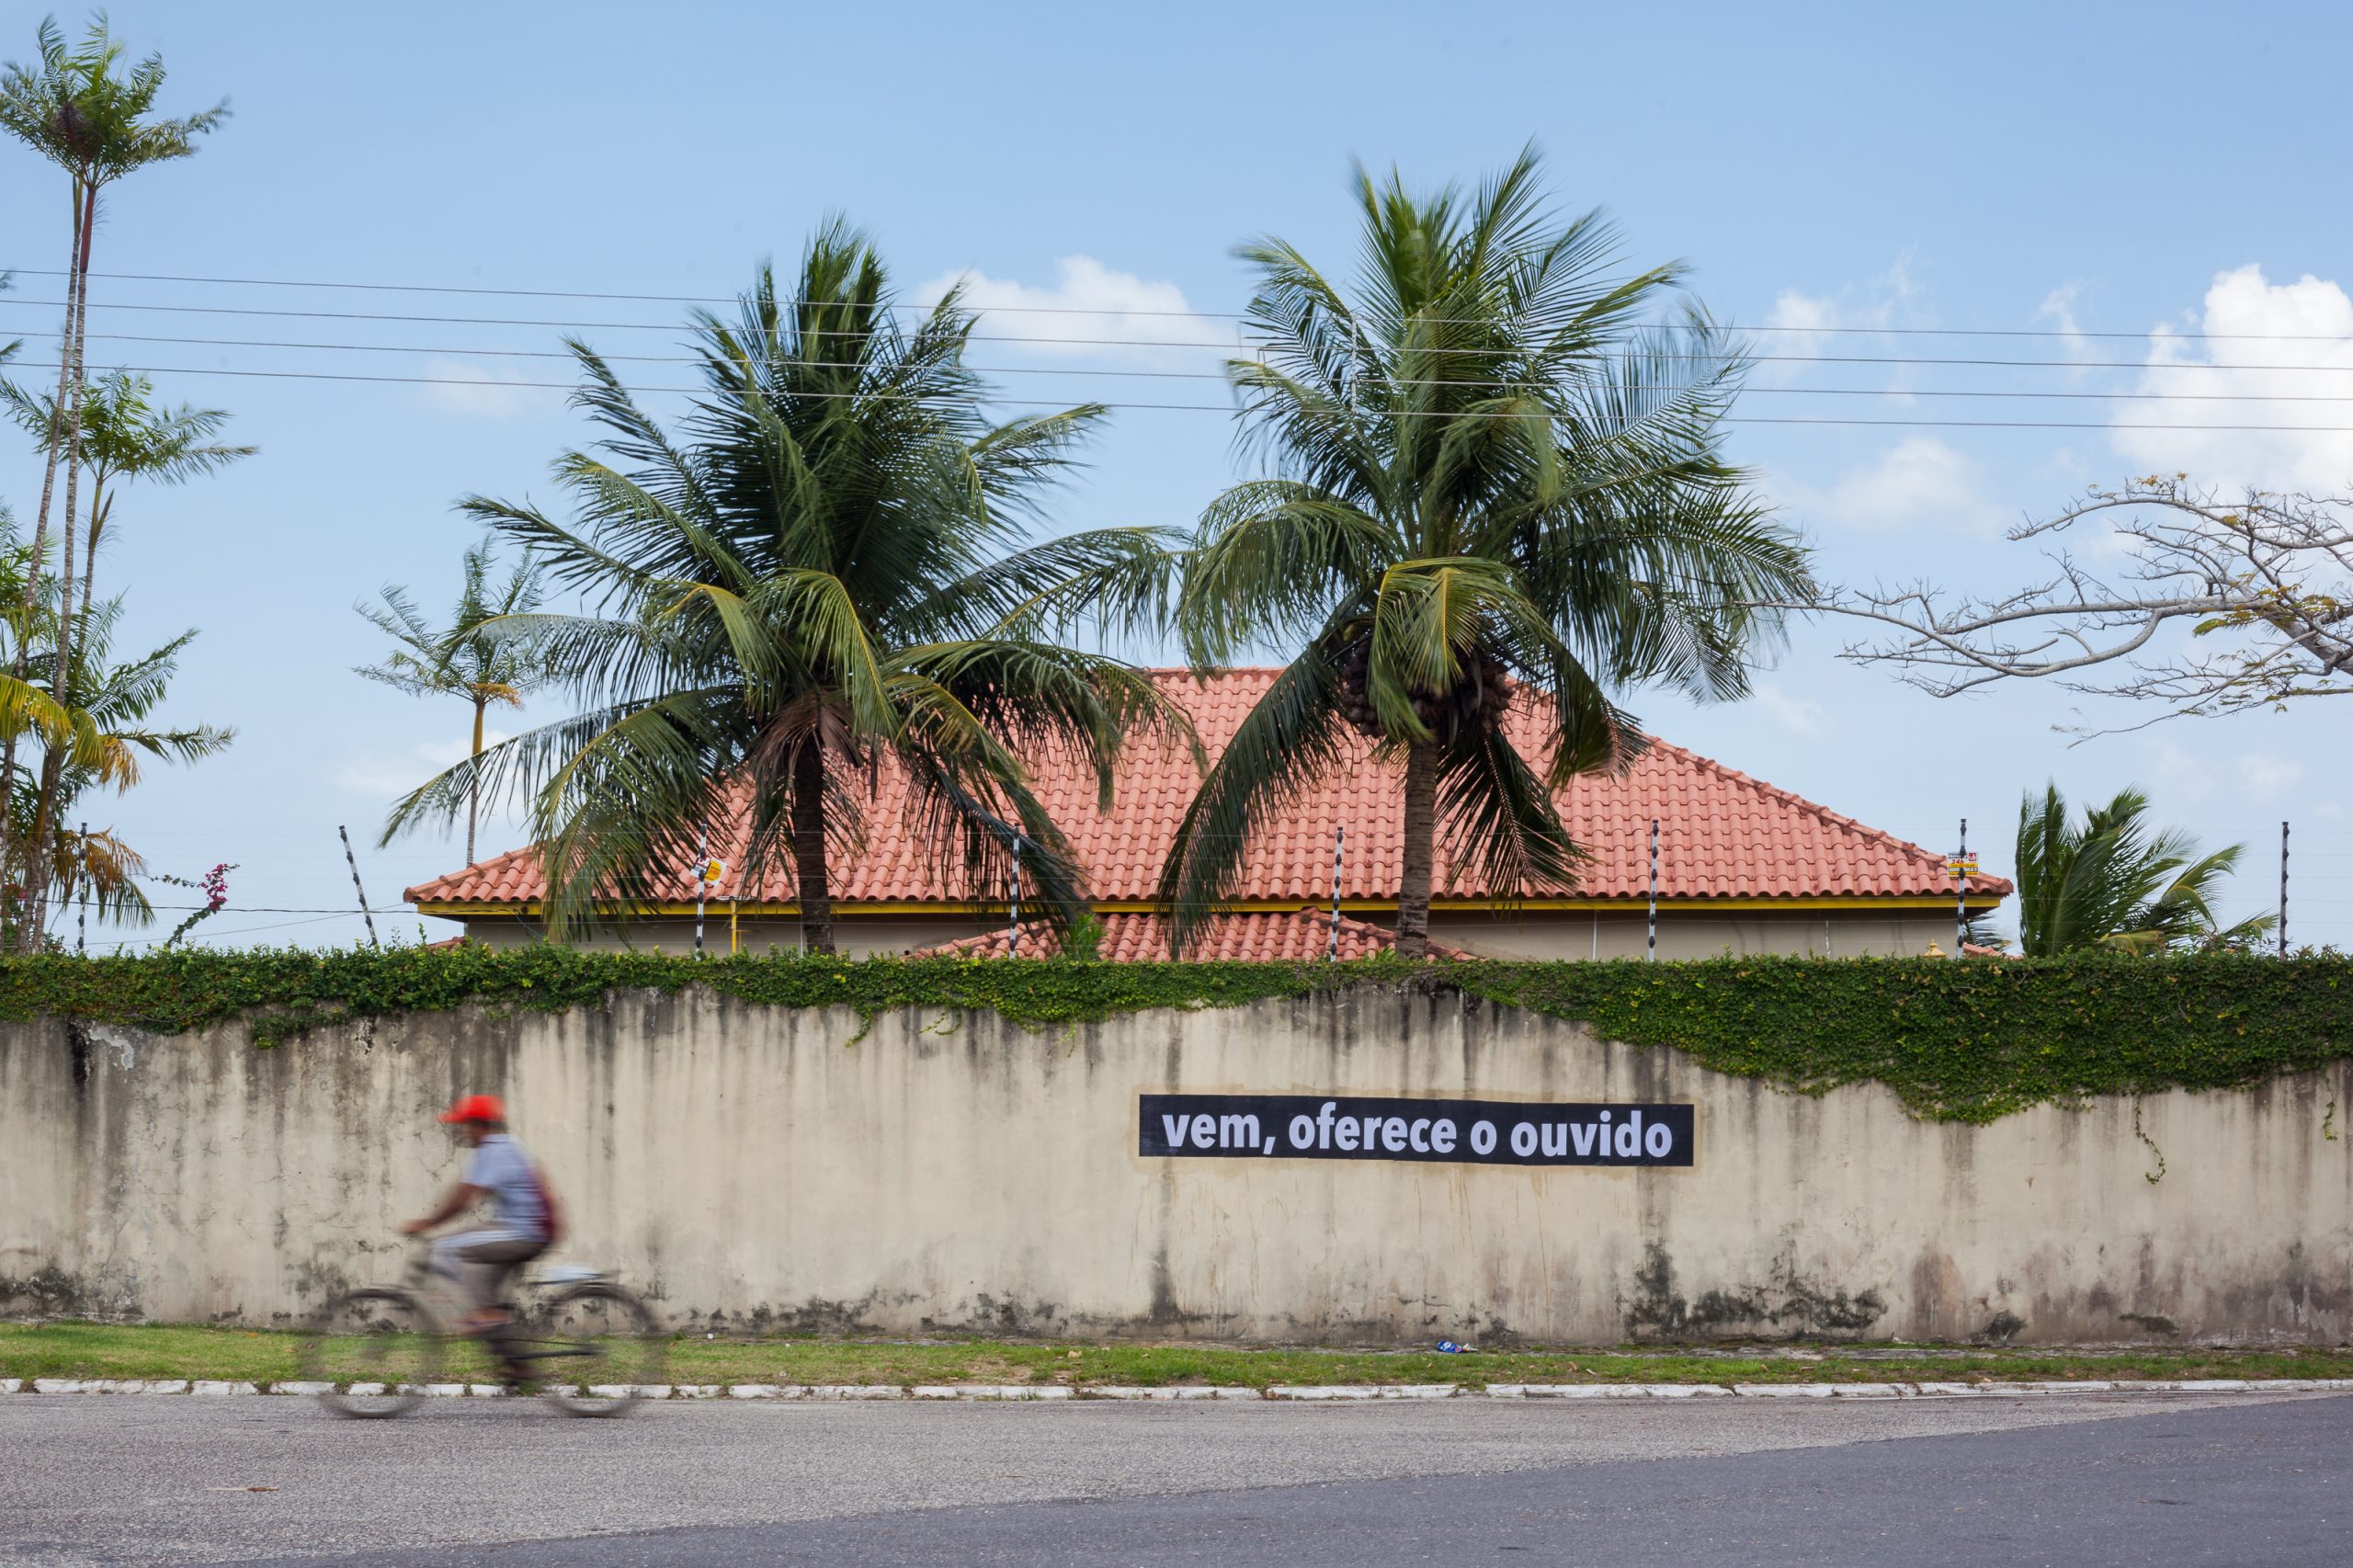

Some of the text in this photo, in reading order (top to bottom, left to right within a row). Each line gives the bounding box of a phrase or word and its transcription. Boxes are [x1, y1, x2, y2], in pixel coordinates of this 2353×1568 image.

[1162, 1102, 1673, 1158] vem, oferece o ouvido
